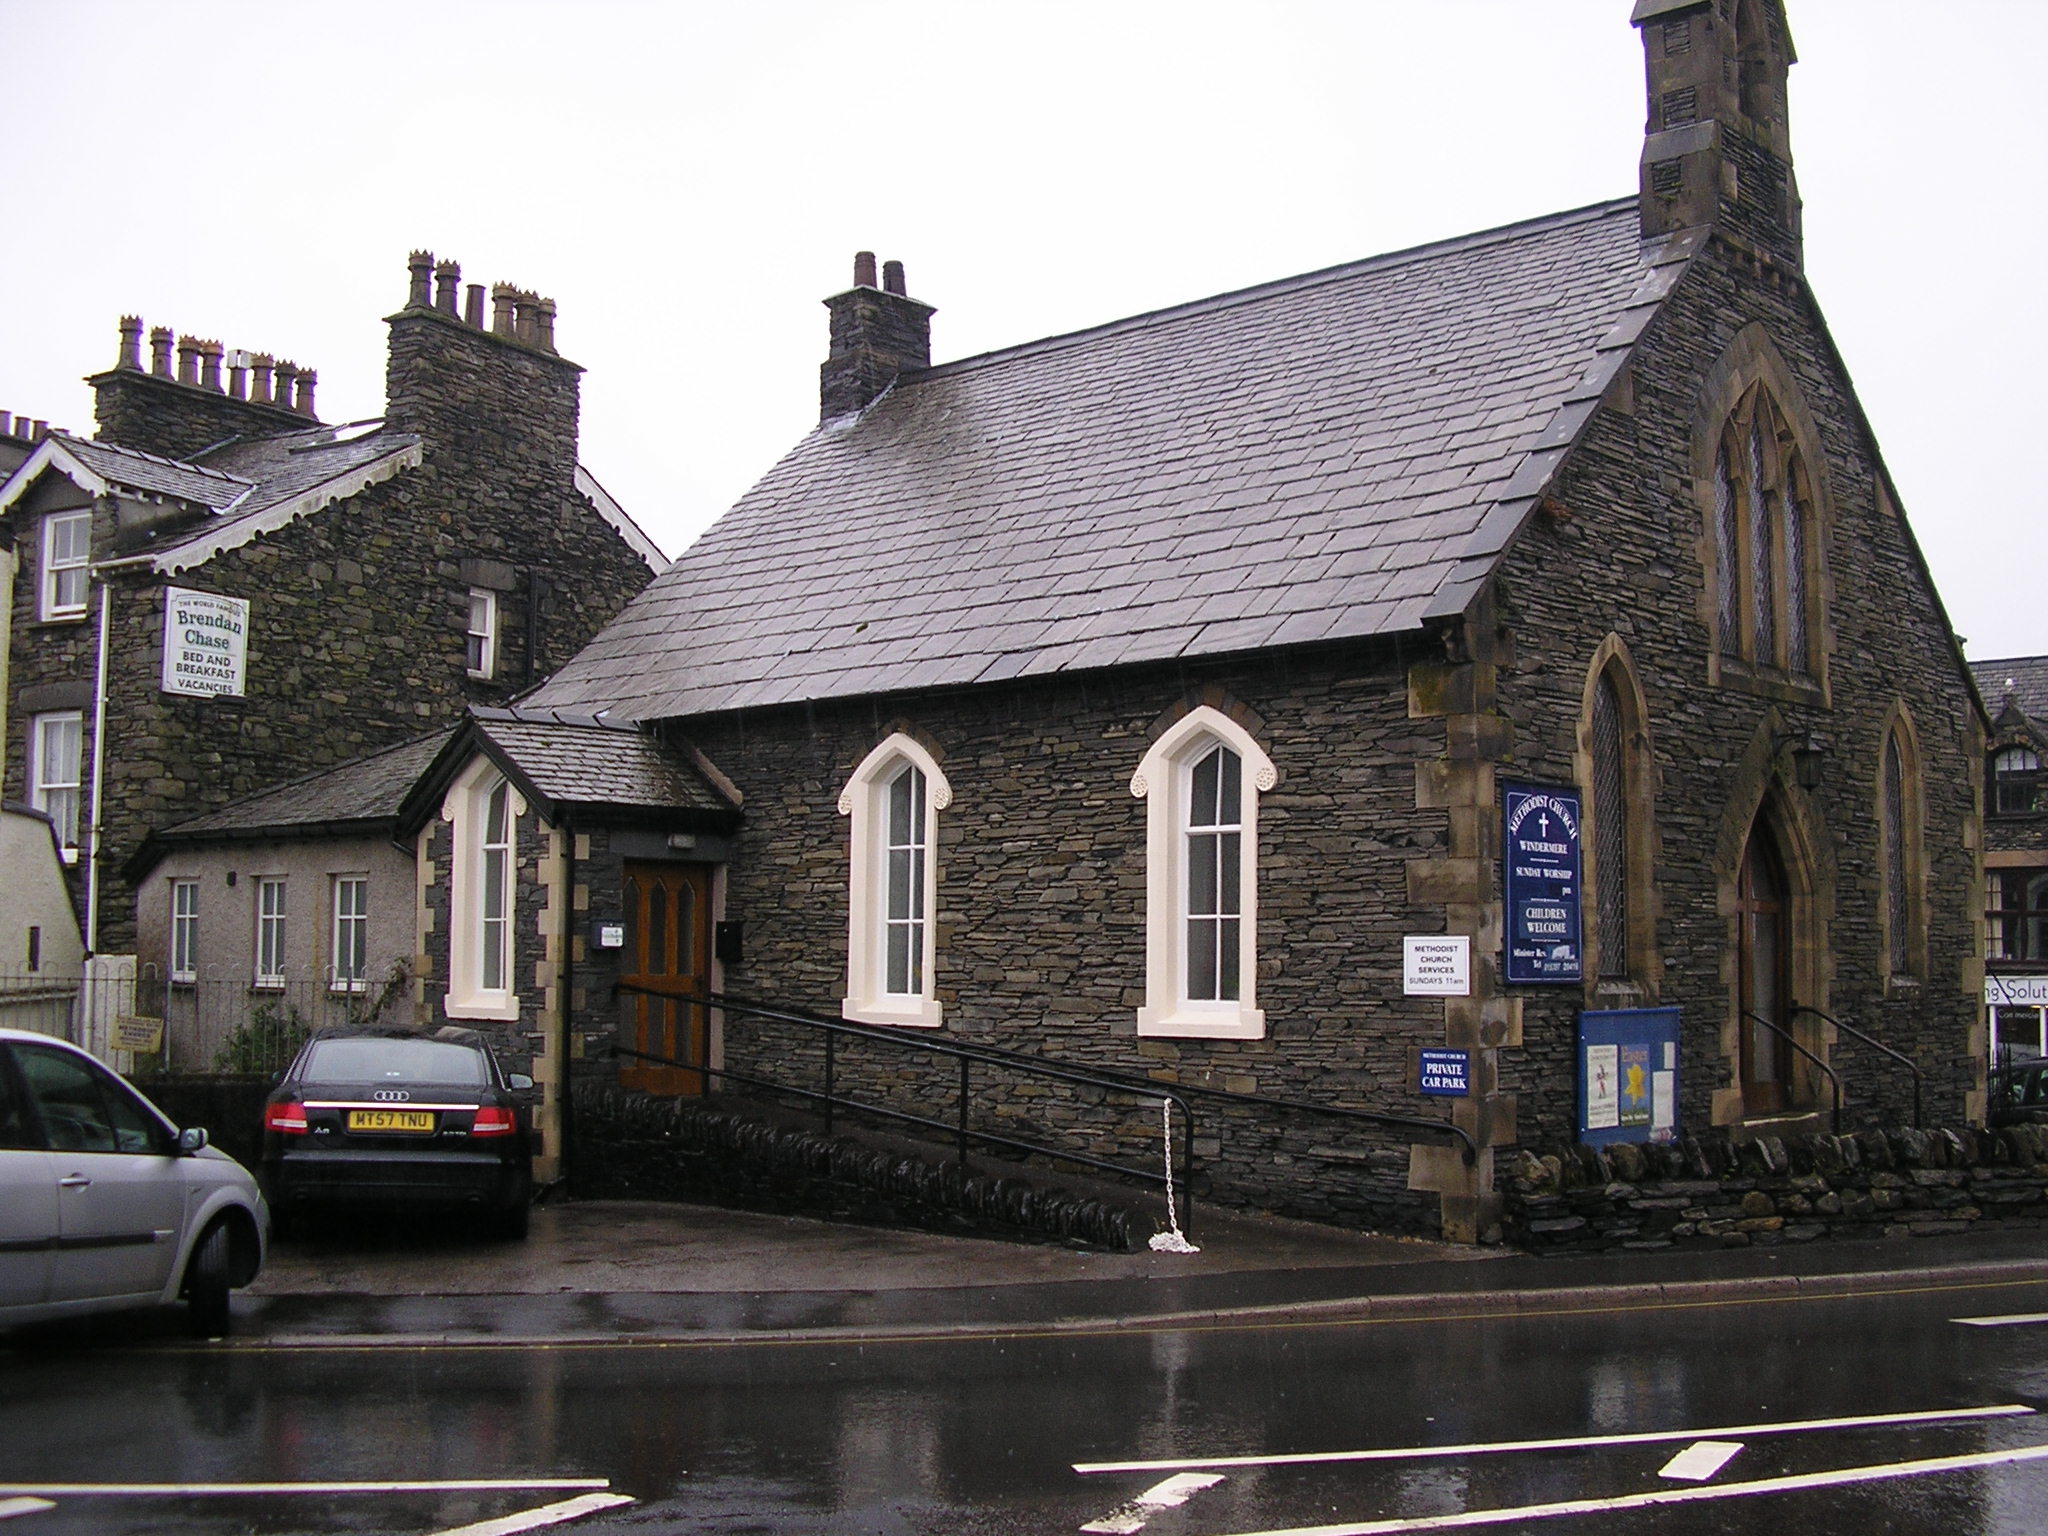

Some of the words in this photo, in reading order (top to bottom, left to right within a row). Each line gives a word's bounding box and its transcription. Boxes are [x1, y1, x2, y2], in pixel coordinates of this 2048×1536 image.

[193, 600, 215, 609] WORLD
[216, 603, 241, 617] FAMOUS
[176, 610, 242, 635] Brendan
[184, 629, 230, 650] Chase
[183, 651, 204, 663] BED
[206, 654, 231, 667] AND
[176, 662, 236, 680] BREAKFAST
[177, 678, 233, 694] VACANCIES
[1510, 795, 1549, 836] METHODIST
[1549, 798, 1577, 840] CHURCH
[1519, 839, 1568, 855] WINDERMERE
[1516, 866, 1541, 878] SUNDAY
[1543, 868, 1573, 880] WORSHIP
[1526, 907, 1567, 919] CHILDREN
[1527, 922, 1567, 933] WELCOME
[1418, 966, 1454, 974] SERVICES
[1409, 977, 1443, 985] SUNDAYS
[1446, 977, 1464, 985] 11am
[2006, 979, 2047, 999] Solut
[1426, 1063, 1463, 1075] PRIVATE
[1422, 1076, 1441, 1088] CAR
[1442, 1077, 1467, 1089] PARK
[400, 1113, 428, 1127] TNU
